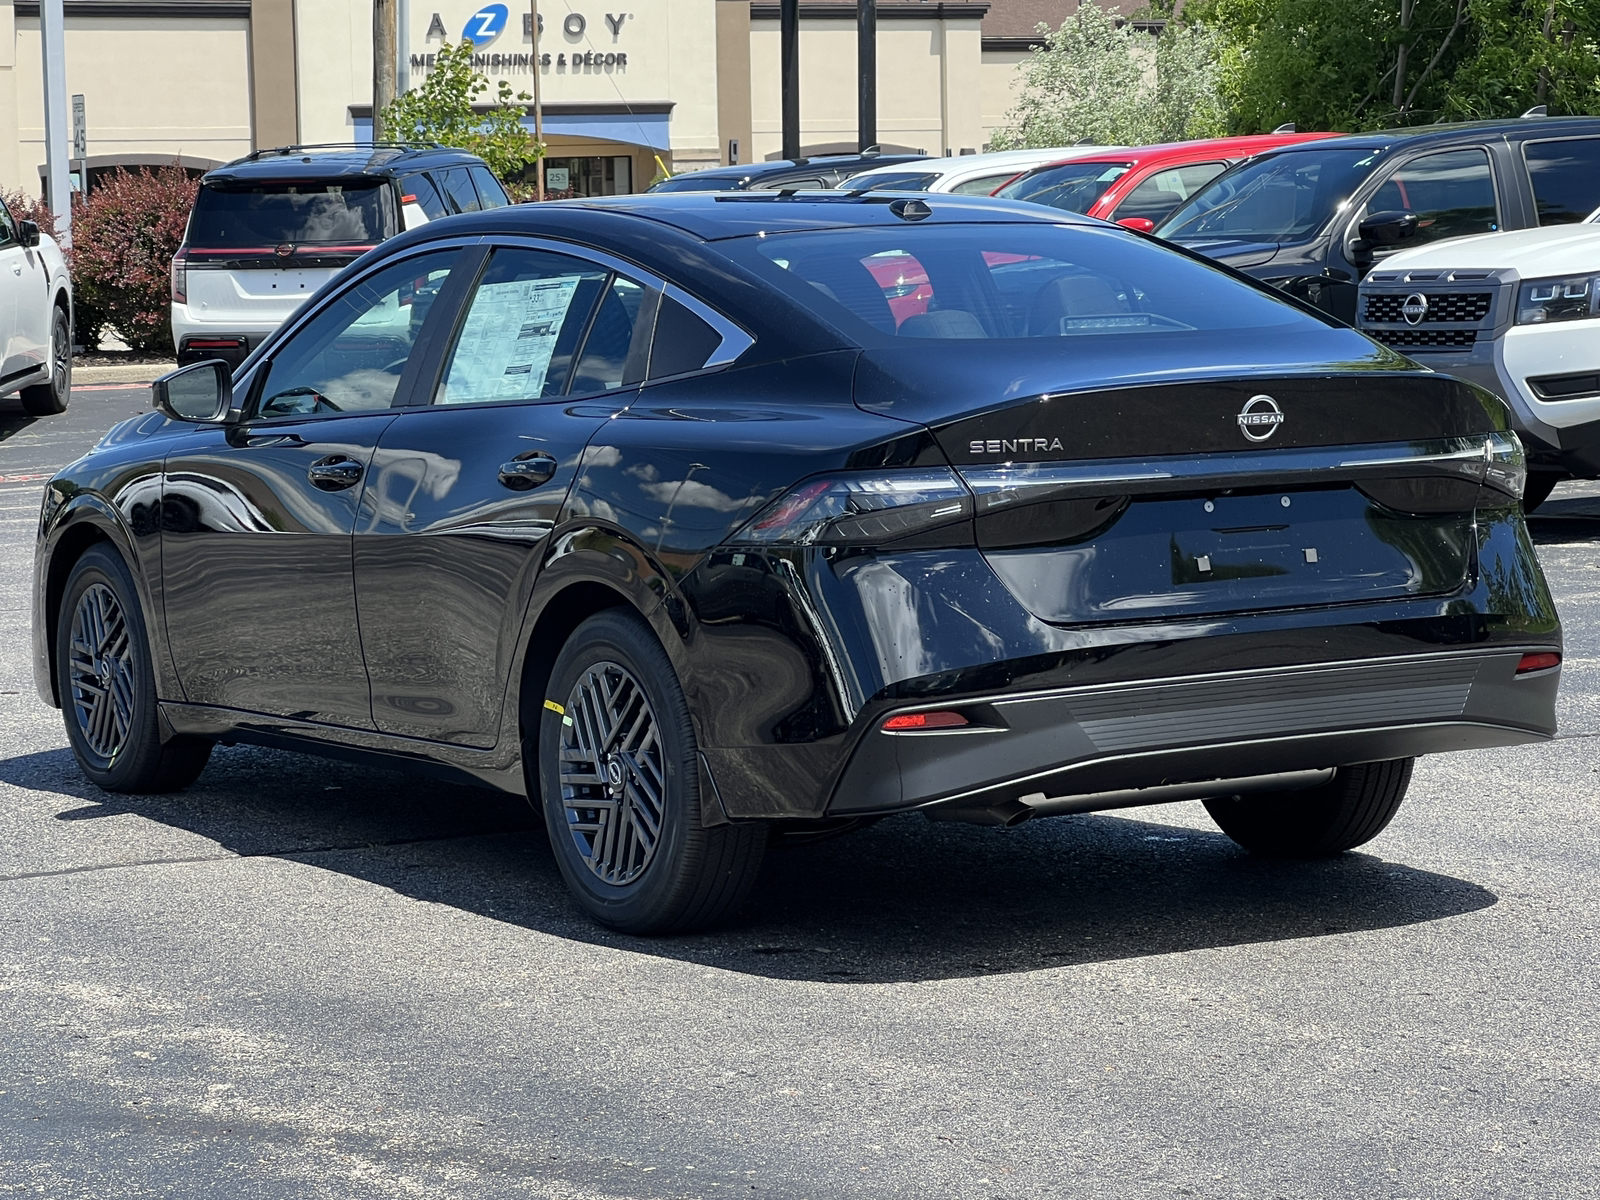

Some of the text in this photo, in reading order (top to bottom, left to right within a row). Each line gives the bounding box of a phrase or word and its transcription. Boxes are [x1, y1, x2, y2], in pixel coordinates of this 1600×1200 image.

[557, 53, 567, 66] &
[572, 50, 628, 66] DÉCOR
[75, 129, 85, 152] 45
[1238, 414, 1284, 424] NISSAN
[969, 437, 1064, 453] SENTRA
